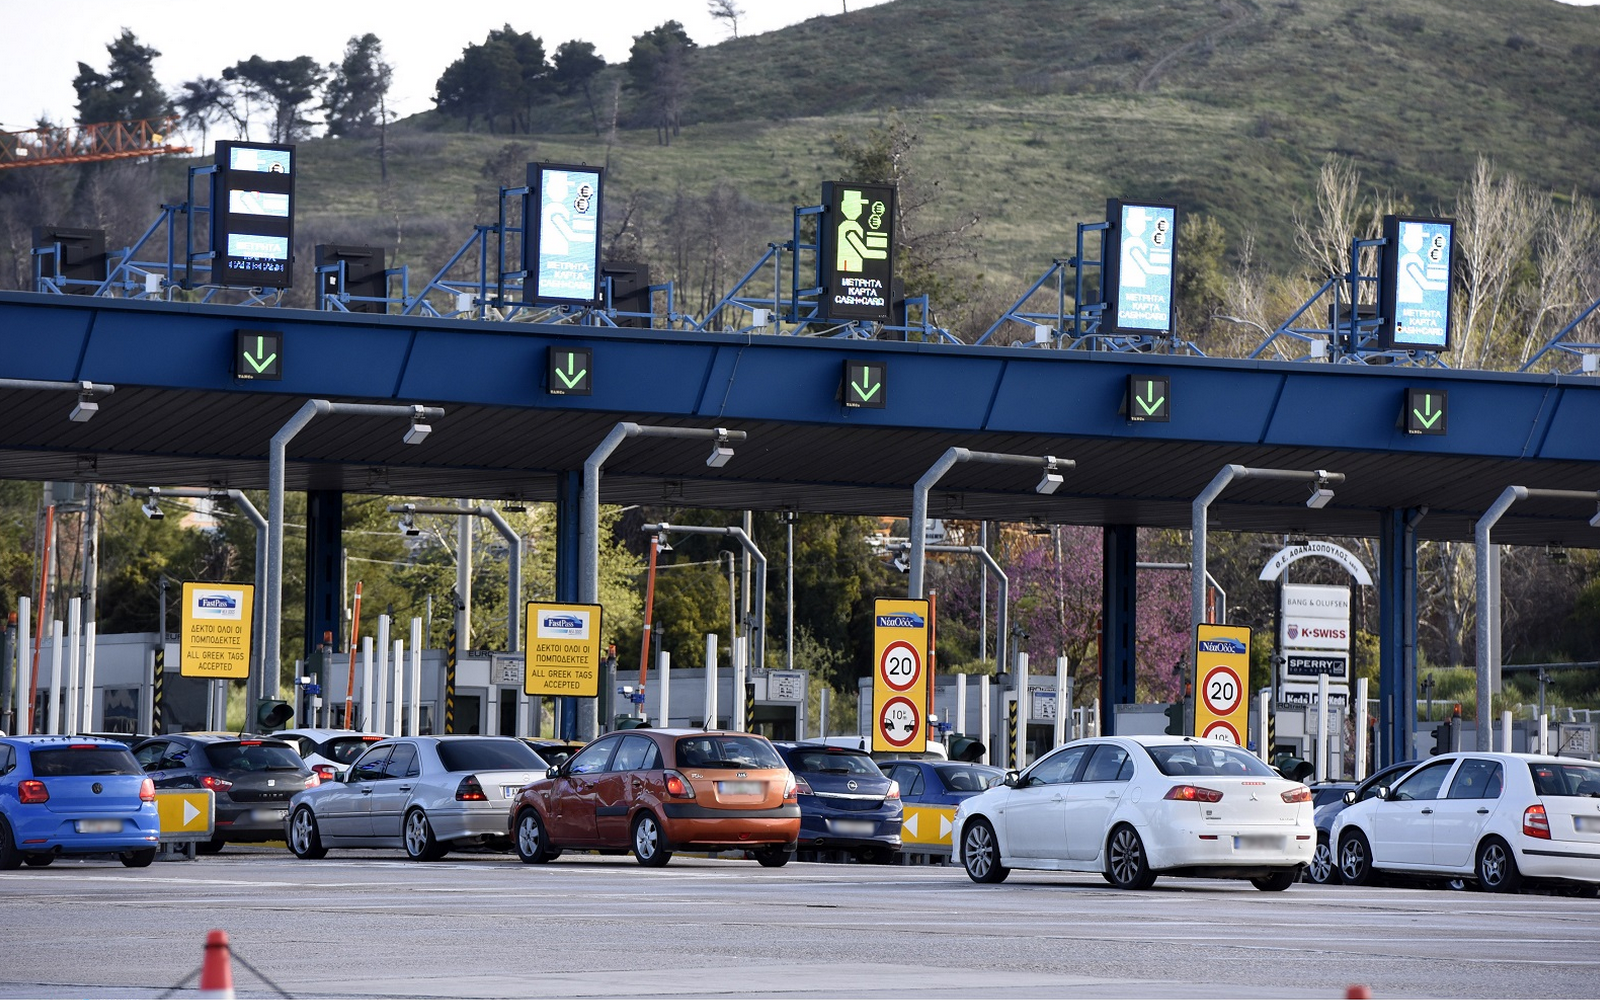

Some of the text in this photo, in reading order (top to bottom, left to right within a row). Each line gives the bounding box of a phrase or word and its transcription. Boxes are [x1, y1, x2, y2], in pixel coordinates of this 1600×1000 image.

[848, 287, 878, 297] ΚΑΡΤΑ
[202, 599, 228, 607] FastPass
[1287, 598, 1307, 606] BANG
[1316, 599, 1348, 608] OLUFSEN
[548, 619, 574, 627] FastPass
[191, 625, 242, 634] ΔΕΚΤΟΙ ΟΛΟΙ ΟΙ
[190, 636, 241, 645] ΠΟΜΠΟΔΕΚΤΕΣ
[536, 644, 590, 653] ΔΕΚΤΟΙ ΟΛΟΙ ΟΙ
[187, 651, 244, 660] ALL GREEK TAGS
[536, 654, 589, 664] ΠΟΜΠΟΔΕΚΤΕΣ
[198, 662, 232, 671] ACCEPTED
[889, 657, 912, 676] 20
[1289, 659, 1333, 669] SPERRY
[532, 670, 593, 679] ALL GREEK TAGS
[544, 681, 580, 689] ACCEPTED
[1211, 682, 1234, 701] 20
[892, 709, 903, 720] 10
